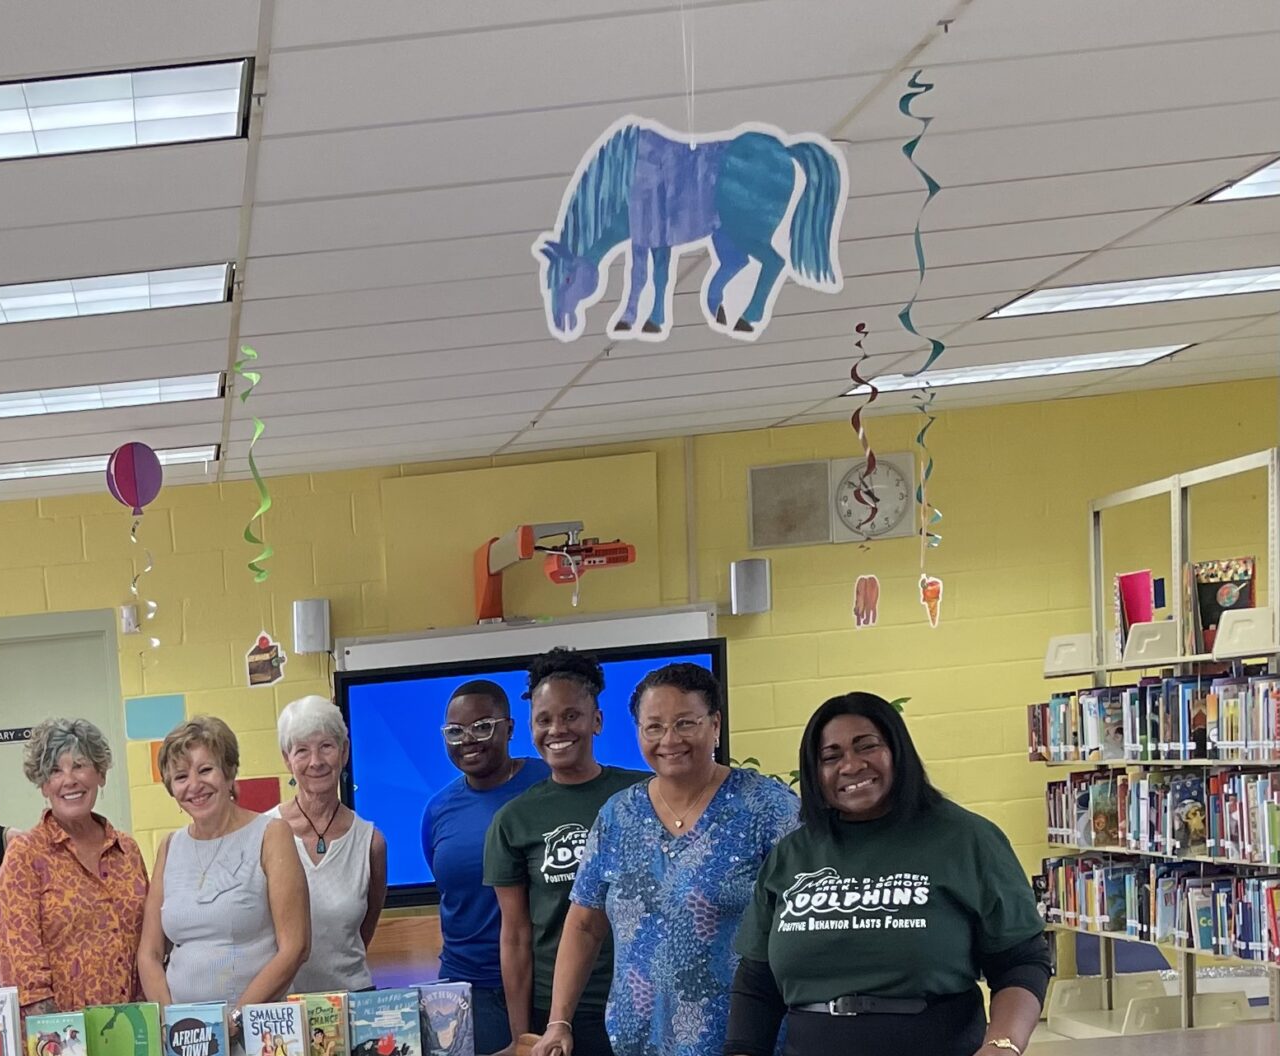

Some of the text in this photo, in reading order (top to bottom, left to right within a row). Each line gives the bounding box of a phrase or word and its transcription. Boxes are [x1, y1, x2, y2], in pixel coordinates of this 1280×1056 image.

[822, 877, 858, 887] PEARL
[879, 873, 929, 883] LARSEN
[875, 880, 930, 889] SCHOOL
[795, 887, 930, 908] DOLPHINS
[808, 917, 849, 931] BEHAVIOR
[852, 916, 881, 929] LASTS
[884, 915, 927, 929] FOREVER
[249, 1007, 294, 1022] SMALLER
[251, 1019, 296, 1036] SISTER
[172, 1026, 213, 1047] AFRICAN
